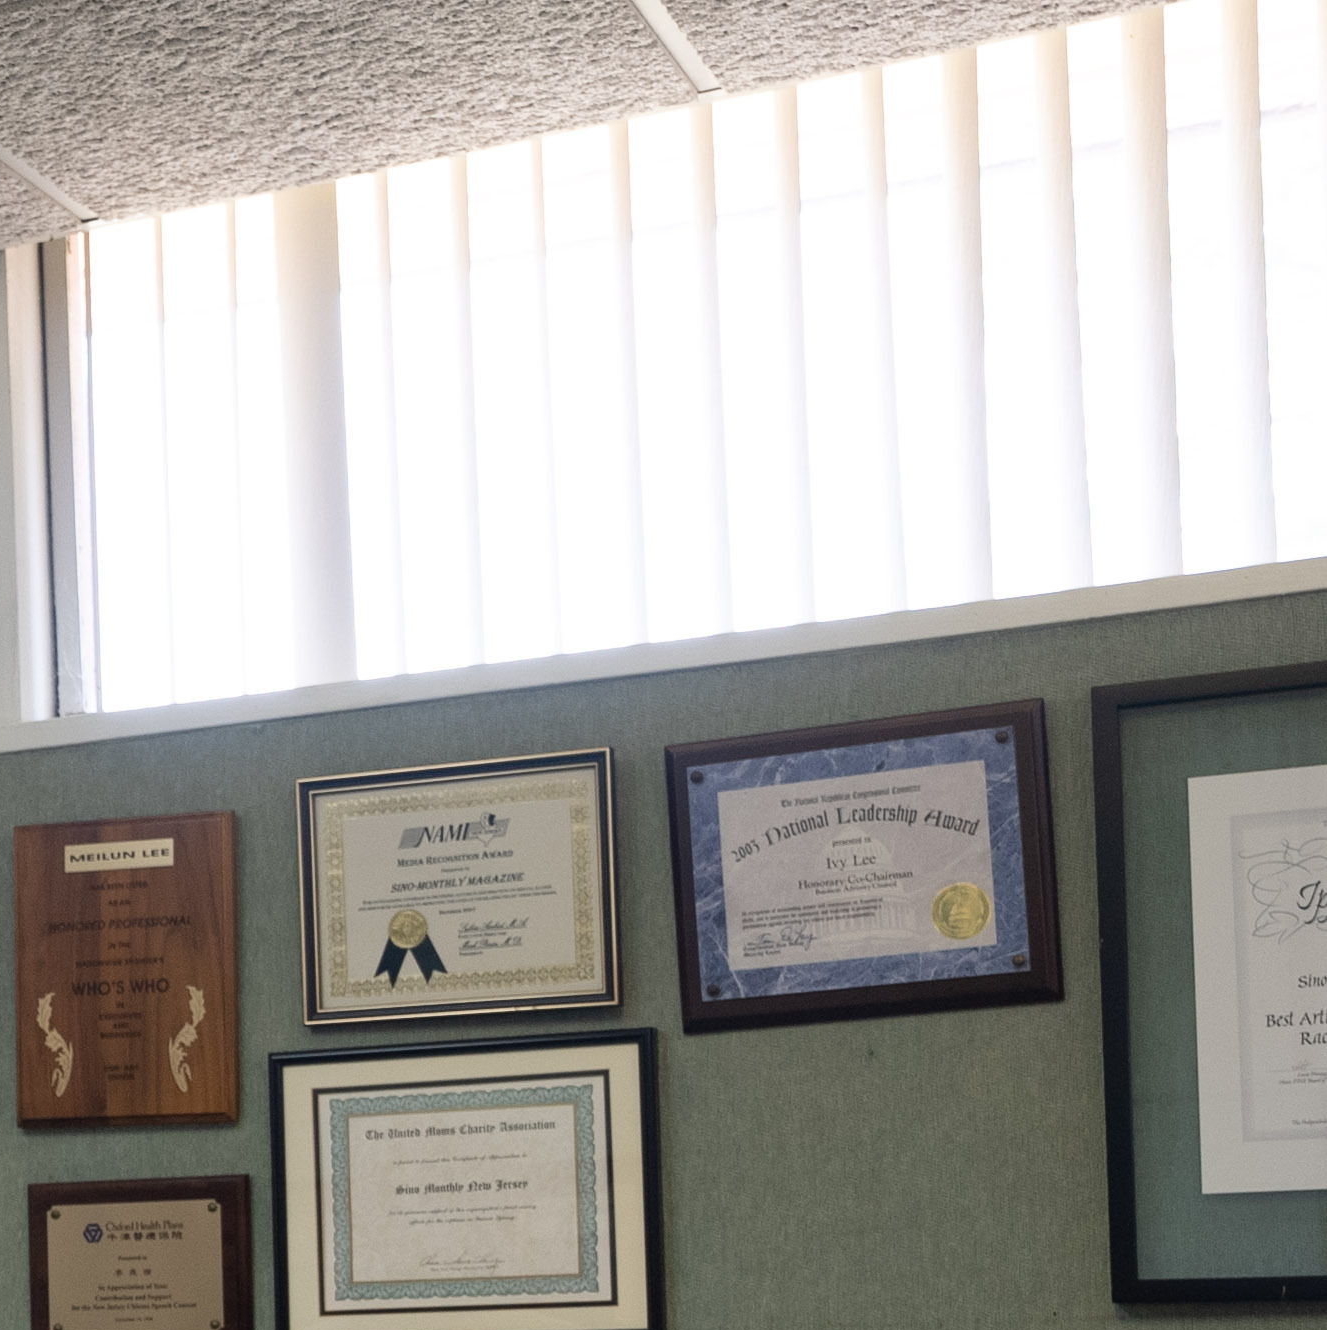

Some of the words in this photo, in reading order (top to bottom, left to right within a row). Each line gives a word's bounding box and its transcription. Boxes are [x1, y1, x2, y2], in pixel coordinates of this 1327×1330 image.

[764, 810, 830, 846] National
[836, 804, 918, 827] Leadership
[924, 809, 981, 837] Award
[414, 822, 471, 848] NAMI
[69, 850, 135, 864] MEILUN
[142, 848, 171, 859] LEE
[826, 857, 848, 870] Ivy
[853, 854, 877, 866] Lee
[390, 875, 466, 893] SINO-MONTHLY
[466, 872, 526, 887] MAGAZINE
[798, 876, 845, 891] Honorary
[847, 869, 914, 885] Co-Chairman
[108, 915, 192, 930] PROFESSIONAL
[72, 980, 126, 997] WHO'S
[130, 978, 170, 994] WHO
[1265, 1011, 1294, 1028] Best
[365, 1130, 385, 1141] The
[387, 1129, 421, 1140] United
[425, 1126, 456, 1138] Moms
[459, 1124, 496, 1136] Charity
[499, 1120, 556, 1132] Association
[395, 1184, 420, 1196] Sino
[424, 1182, 464, 1195] Monthly
[467, 1180, 492, 1193] New
[495, 1179, 529, 1192] Jersey
[135, 1220, 161, 1231] Health
